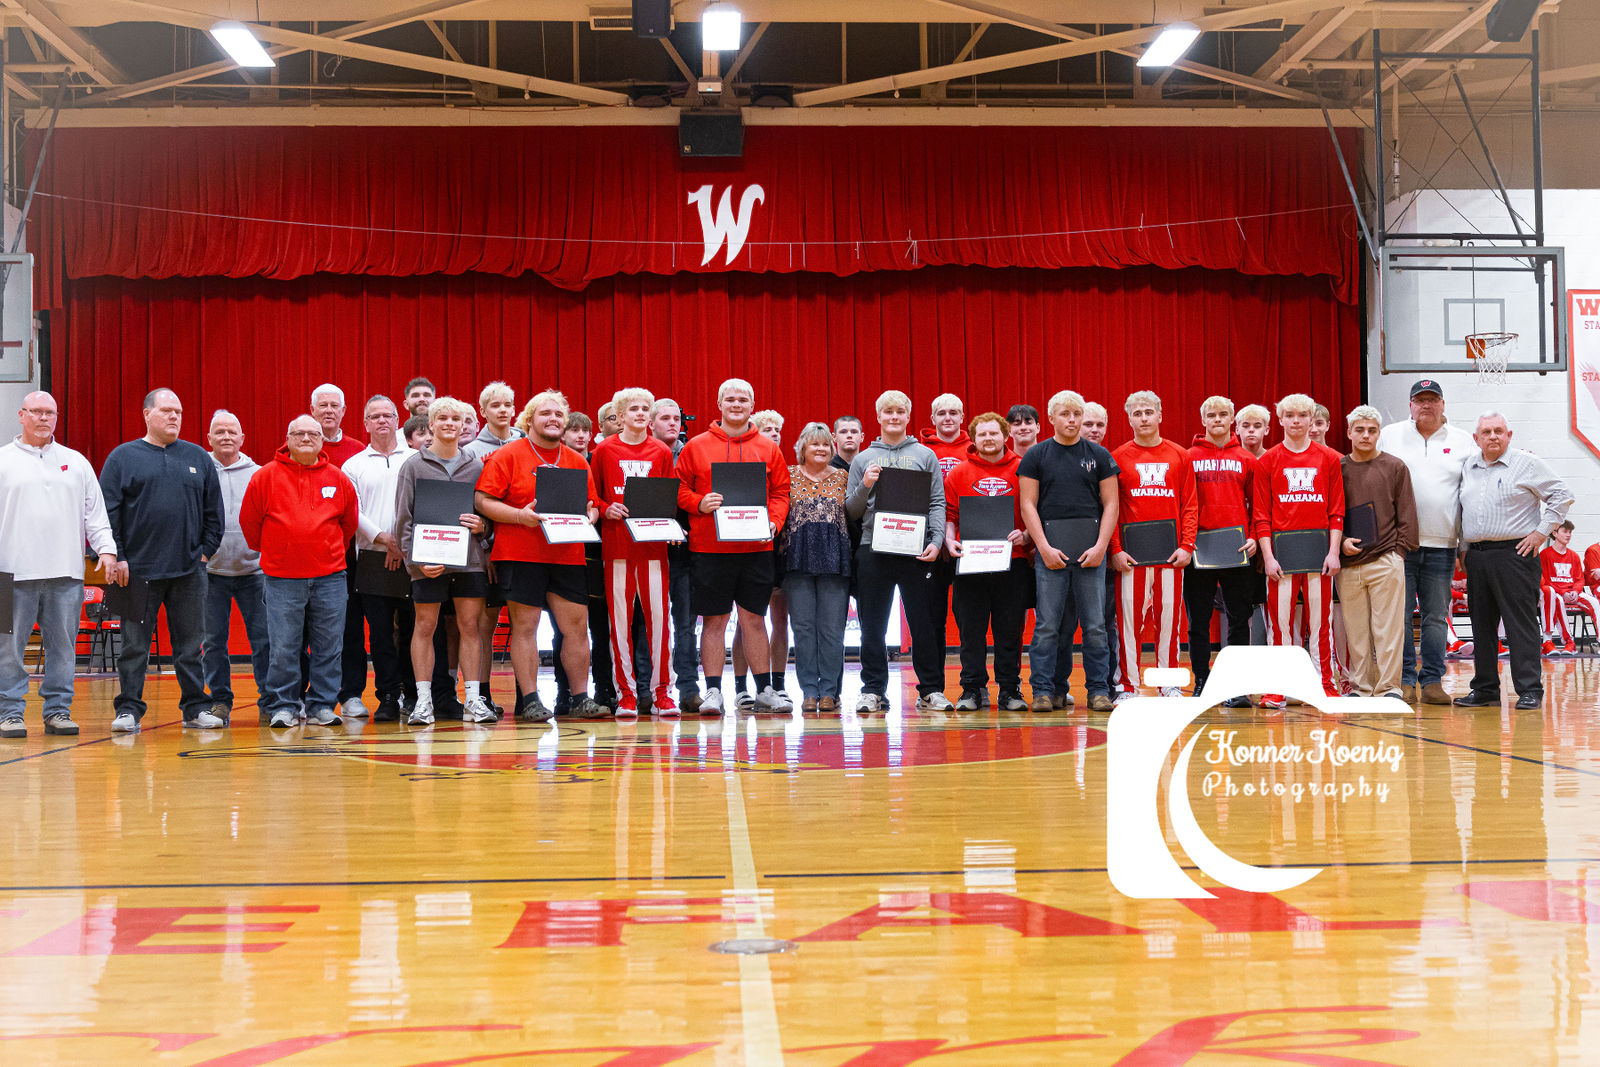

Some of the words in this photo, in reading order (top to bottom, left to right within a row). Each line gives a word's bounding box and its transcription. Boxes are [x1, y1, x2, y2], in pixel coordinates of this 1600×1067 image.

[687, 184, 765, 265] W
[1135, 462, 1170, 483] W
[1192, 459, 1242, 474] WAHAMA
[1283, 467, 1318, 488] W
[1130, 488, 1175, 497] WAHAMA
[1278, 493, 1324, 503] WAHAMA
